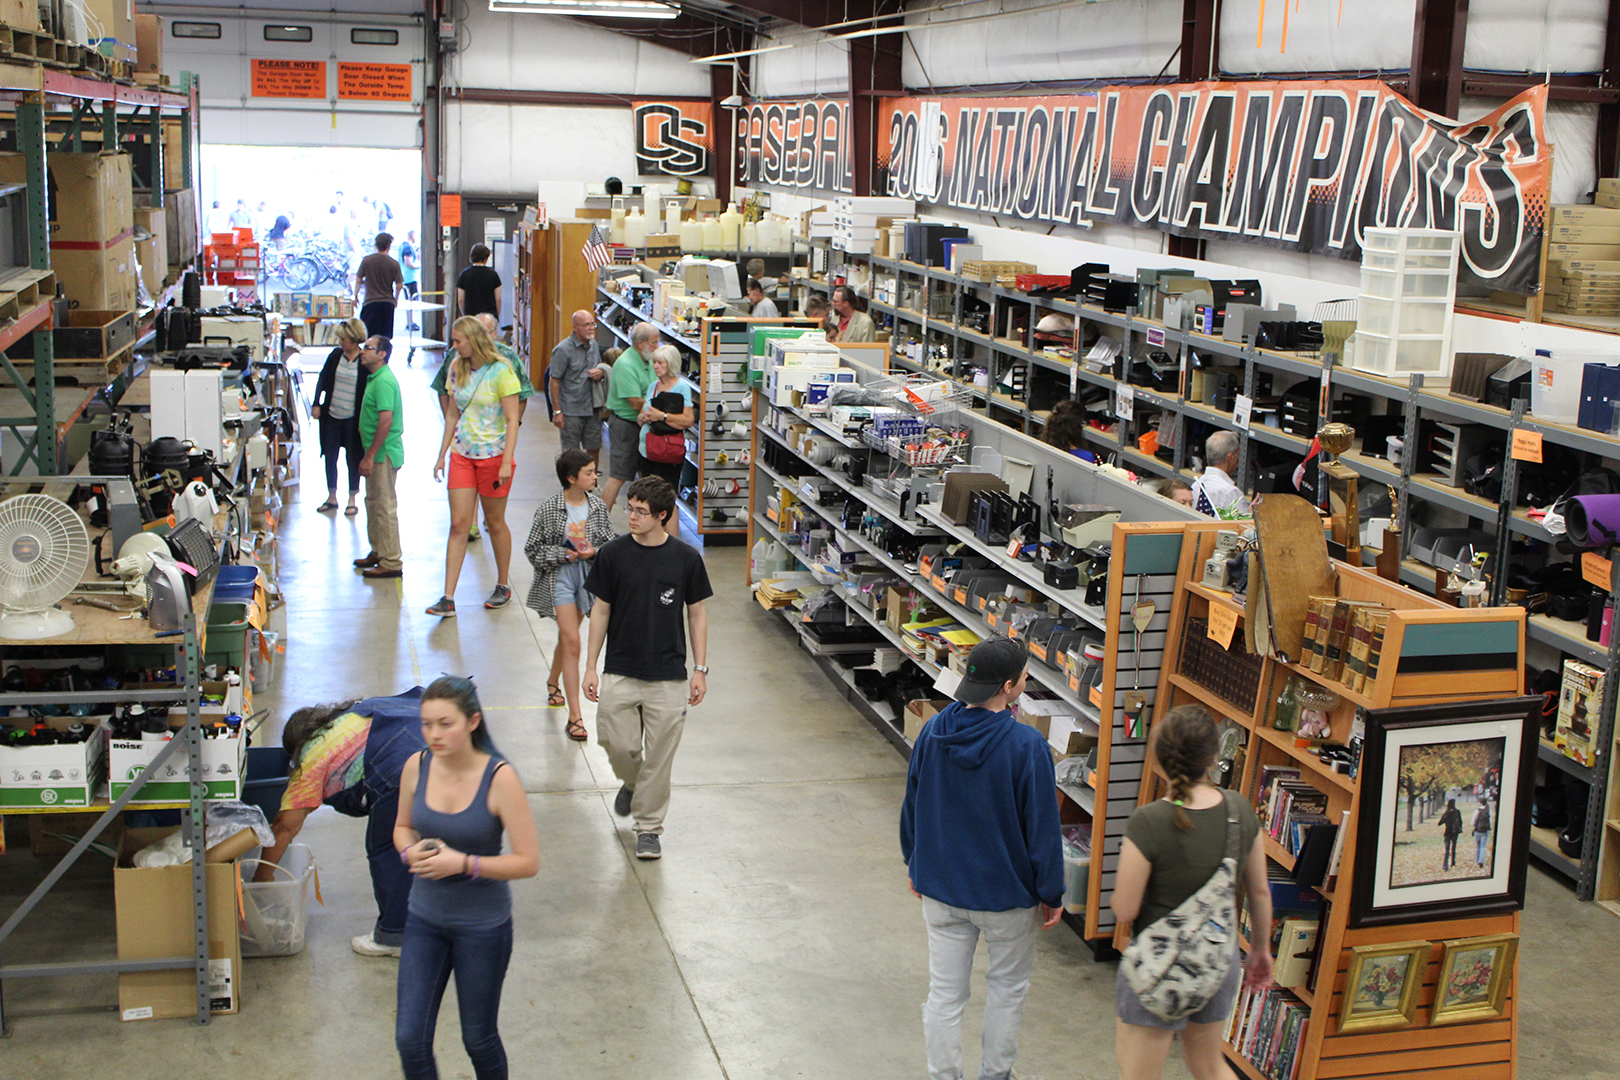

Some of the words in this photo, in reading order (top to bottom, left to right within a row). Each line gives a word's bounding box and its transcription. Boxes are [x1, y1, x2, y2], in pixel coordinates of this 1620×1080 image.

[738, 101, 853, 194] BASEBAL
[948, 91, 1121, 227] NATIONAL
[1130, 88, 1538, 279] CHAMPIONS
